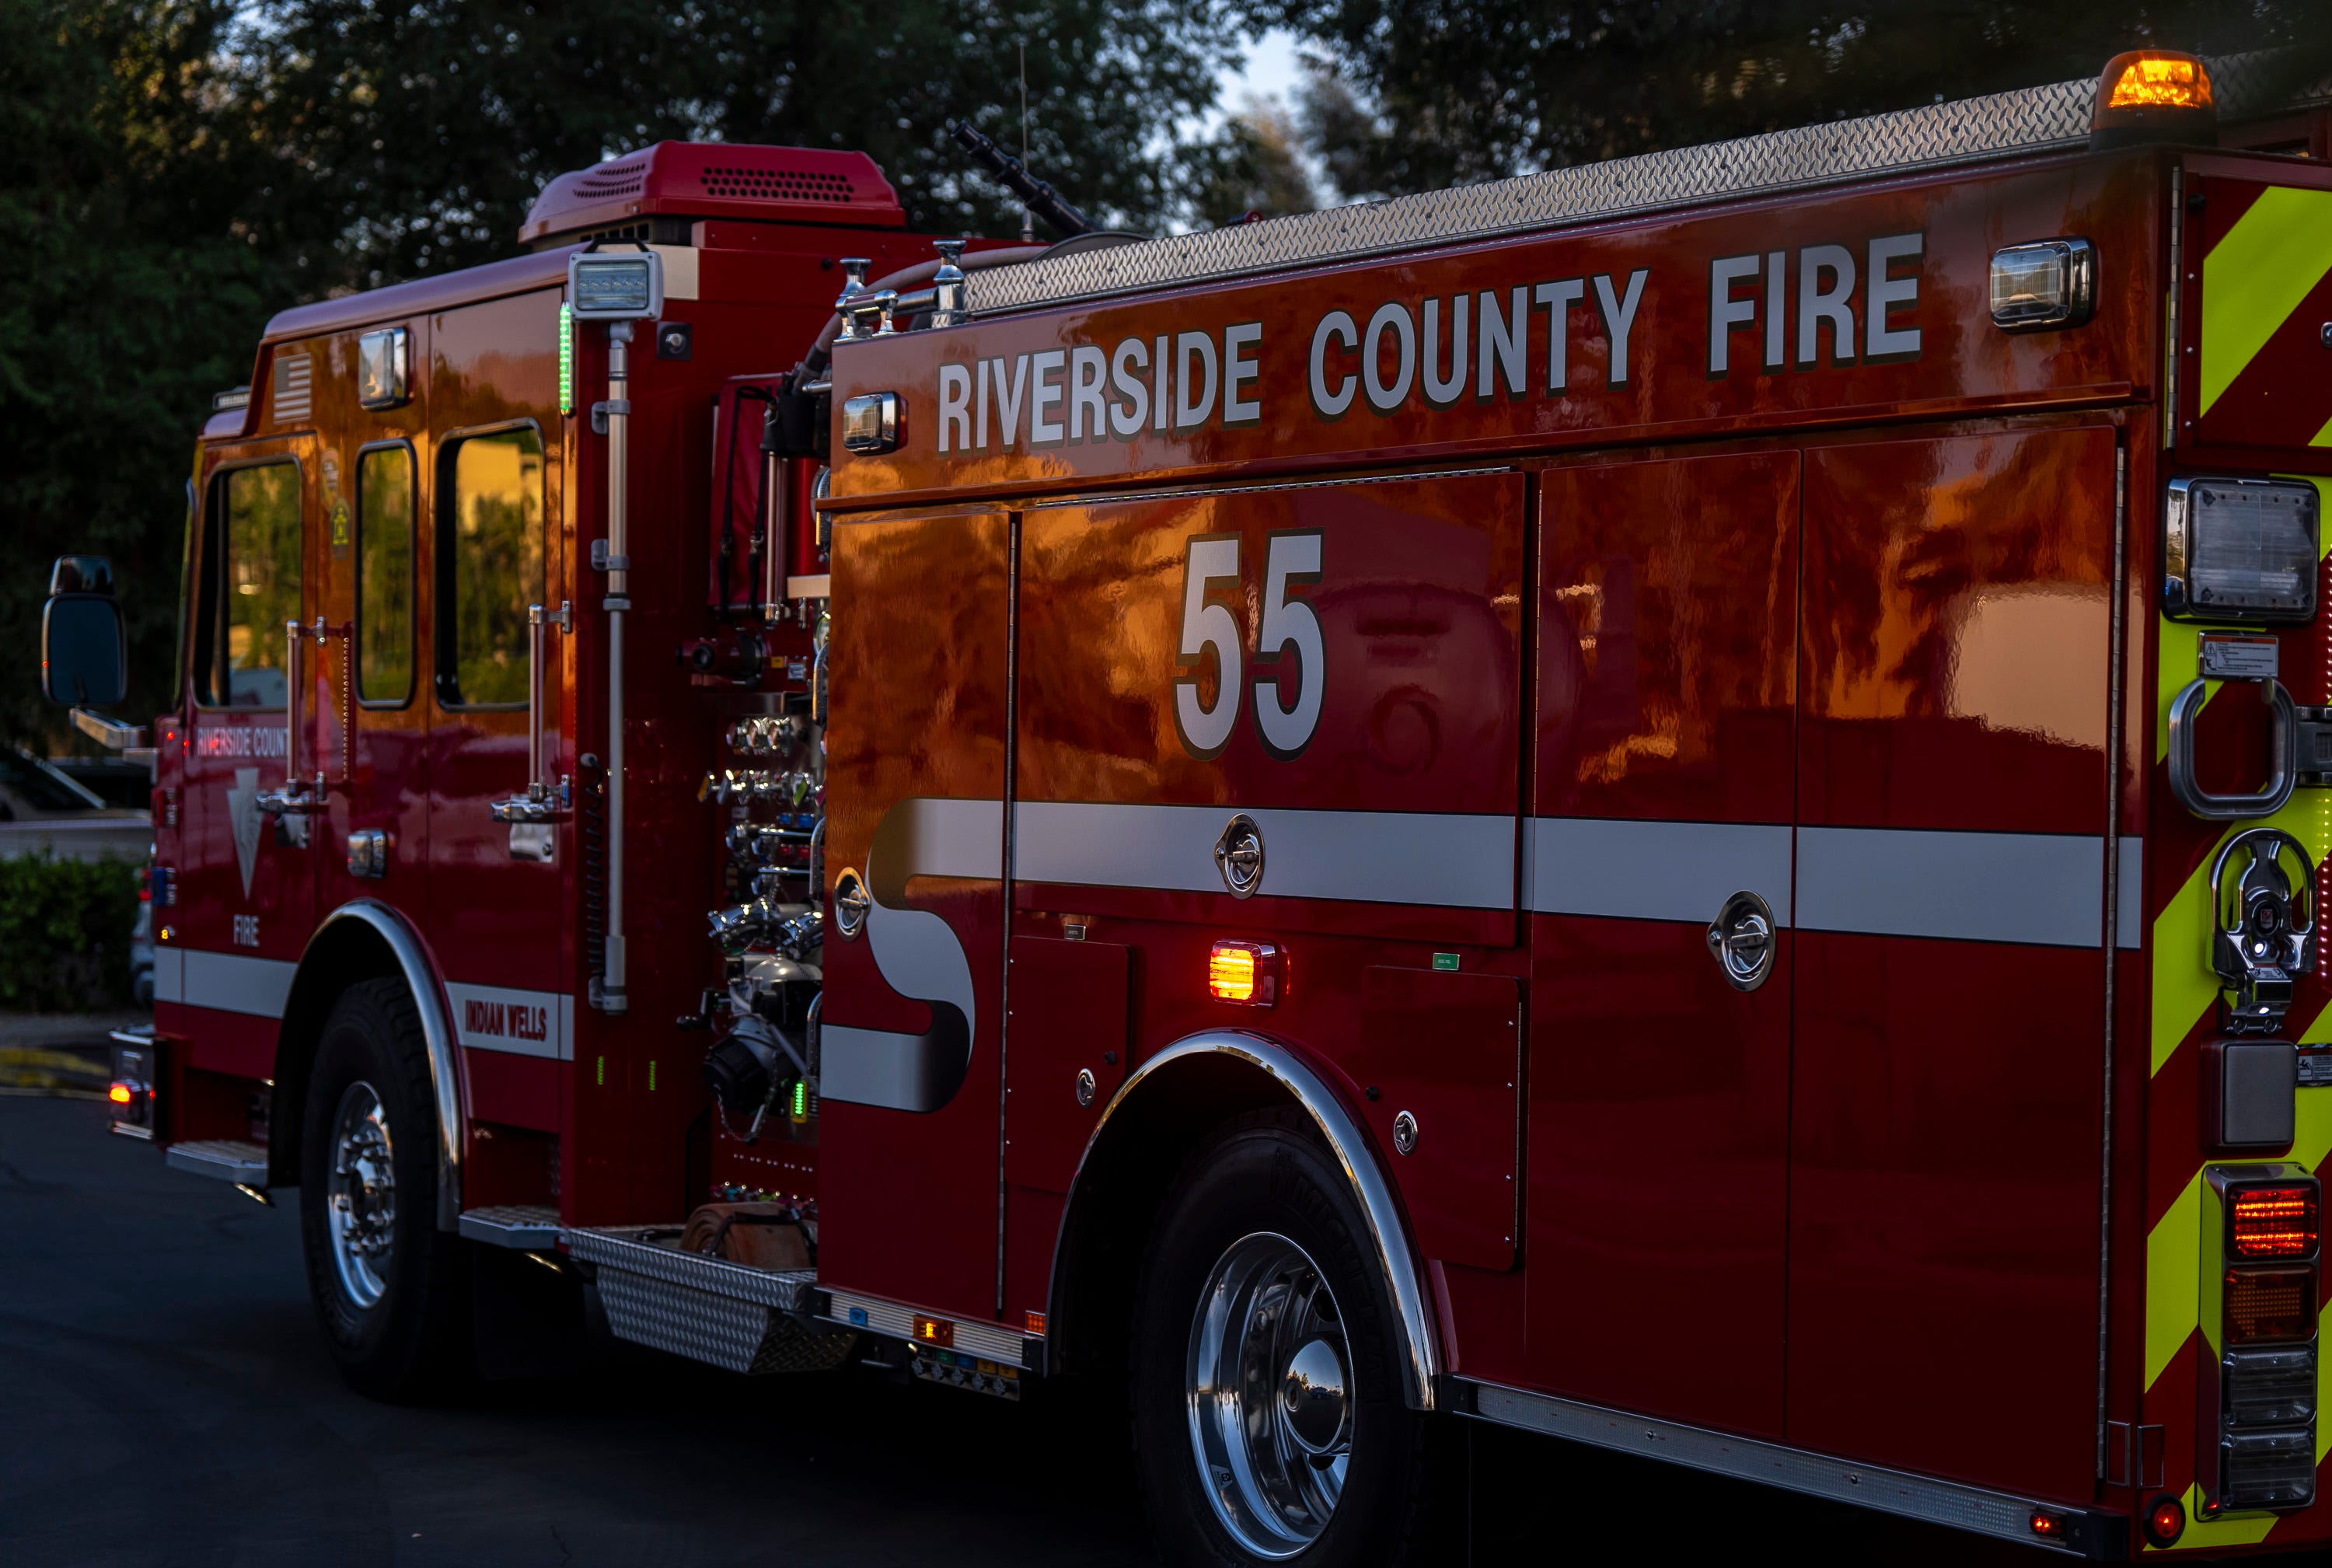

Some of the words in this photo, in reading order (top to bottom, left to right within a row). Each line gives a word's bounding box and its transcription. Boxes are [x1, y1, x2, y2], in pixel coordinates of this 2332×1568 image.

[936, 320, 1262, 456] RIVERSIDE
[1307, 267, 1650, 421] COUNTY
[1708, 232, 1925, 379] FIRE
[1173, 528, 1326, 760] 55
[197, 726, 250, 757] RIVERSIDE
[253, 726, 288, 757] COUNT
[233, 913, 260, 948] FIRE
[466, 1000, 504, 1035] INDIAN
[507, 1004, 546, 1041] WELLS
[1291, 1175, 1390, 1404] MICHELIN
